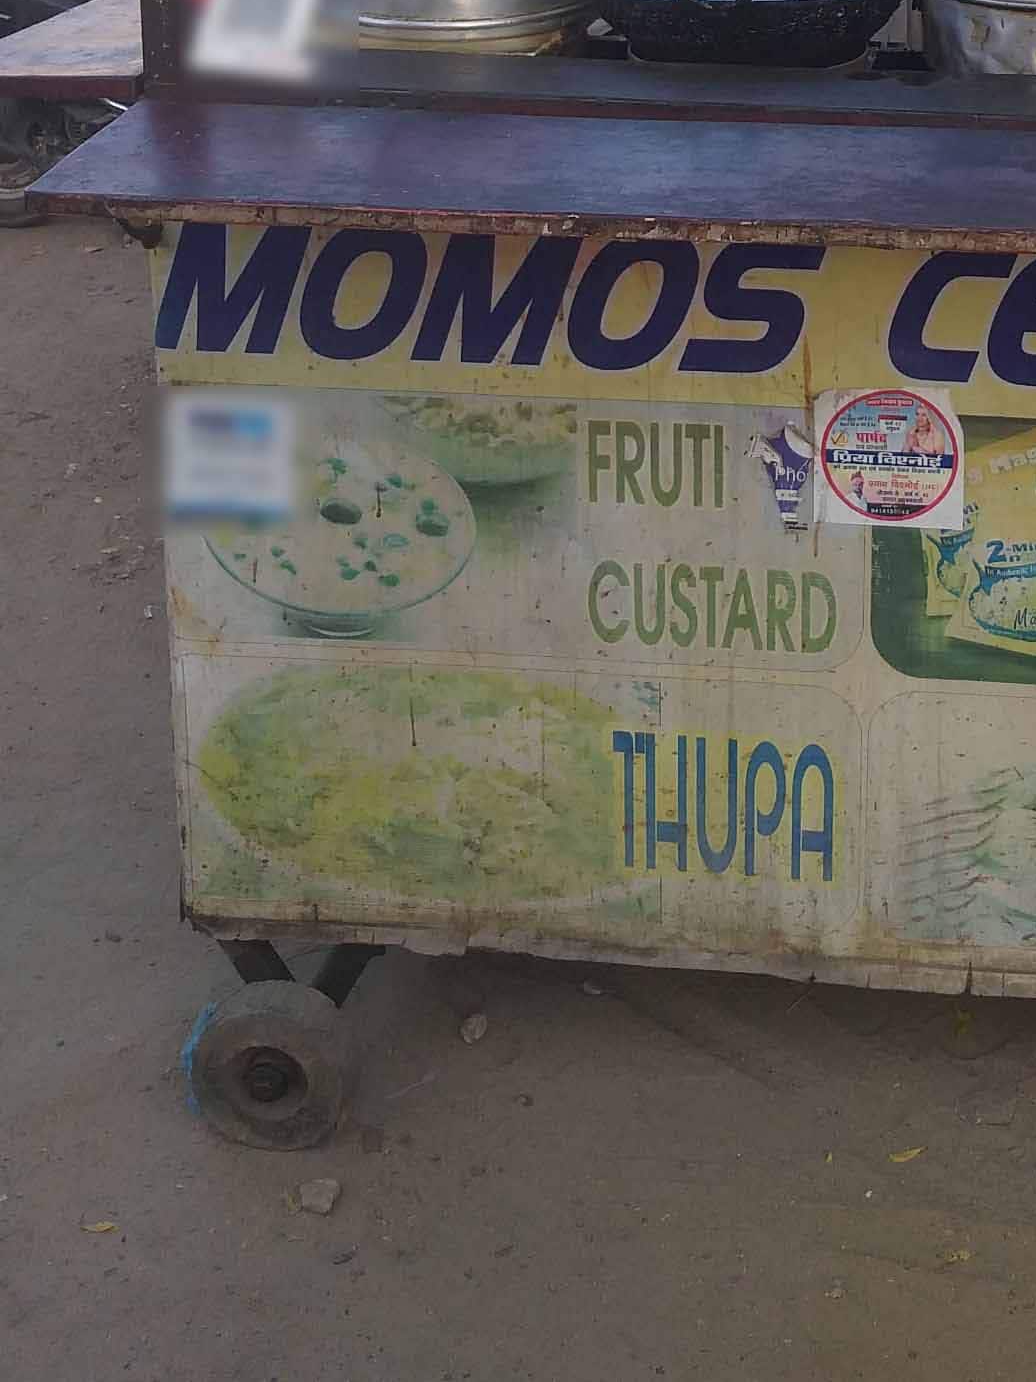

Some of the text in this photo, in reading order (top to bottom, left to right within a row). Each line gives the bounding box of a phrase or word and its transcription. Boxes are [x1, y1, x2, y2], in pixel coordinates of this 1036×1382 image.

[154, 222, 828, 374] MOMOS
[587, 419, 725, 508] FRUTI
[587, 559, 838, 654] CUSTARD
[612, 730, 835, 883] THUPA
